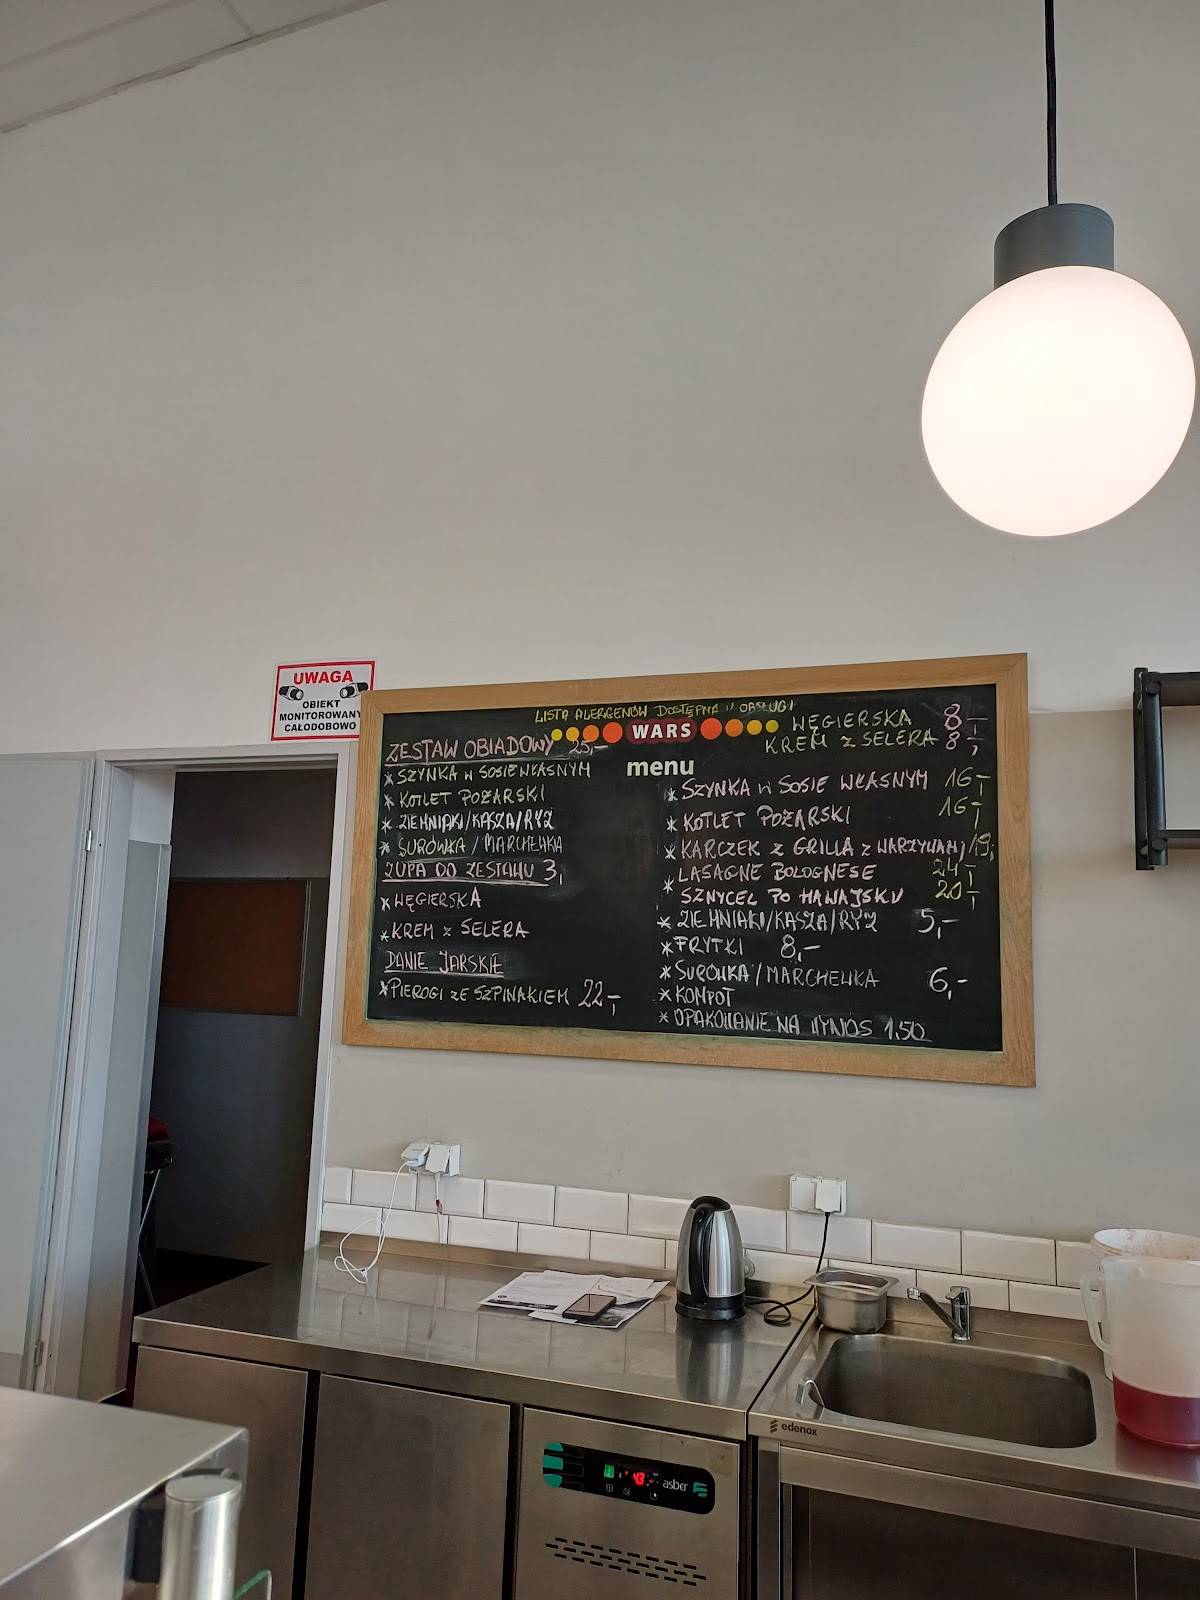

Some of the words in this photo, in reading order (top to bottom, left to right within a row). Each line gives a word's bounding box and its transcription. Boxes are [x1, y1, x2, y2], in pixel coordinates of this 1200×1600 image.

[293, 670, 354, 685] UWAGA
[302, 699, 341, 709] OBIEKT
[534, 708, 569, 723] LISTA
[284, 721, 357, 732] CAŁODOBOWO
[632, 722, 692, 739] WARS
[862, 727, 940, 747] SELERA
[385, 738, 459, 765] ZESTAW
[463, 734, 554, 759] OBIADOWY
[396, 764, 459, 785] SZYNKA
[478, 763, 518, 779] SOSIE
[626, 759, 695, 777] menu
[681, 777, 751, 800] SZYNKA
[778, 774, 830, 795] SOSIE
[399, 790, 453, 808] KOTLET
[683, 810, 746, 833] KOTLET
[681, 837, 761, 861] KARCZEK
[793, 836, 855, 858] GRILLA
[384, 861, 427, 879] ZUPA
[435, 862, 457, 878] DO
[465, 861, 535, 880] ZESTAWU
[678, 862, 764, 884] LASAGNE
[770, 860, 878, 884] BOLOGNESE
[680, 886, 759, 907] SZNYCEL
[767, 887, 791, 905] PO
[391, 922, 434, 940] KREM
[460, 918, 530, 938] SELERA
[673, 935, 744, 956] FRYTKI
[386, 951, 429, 971] DANIE
[438, 950, 505, 974] JARSKIE
[390, 977, 444, 1001] PIEROGI
[474, 984, 570, 1006] SZPINAKIEM
[675, 984, 736, 1008] KOMPOT
[776, 1014, 801, 1036] NA
[781, 1421, 818, 1437] edenox
